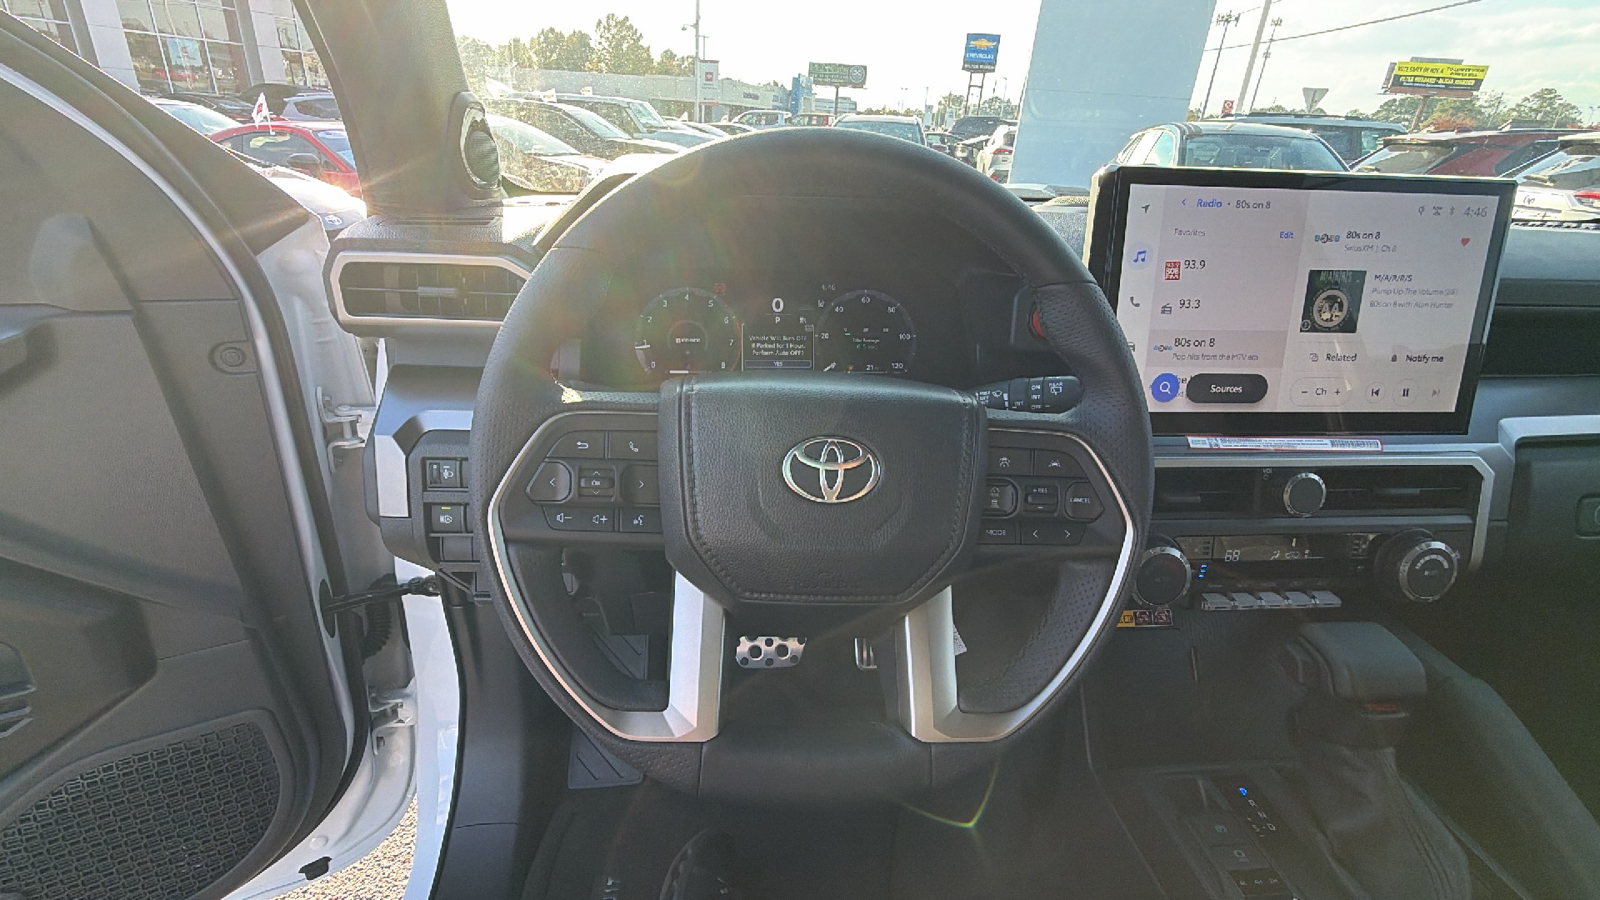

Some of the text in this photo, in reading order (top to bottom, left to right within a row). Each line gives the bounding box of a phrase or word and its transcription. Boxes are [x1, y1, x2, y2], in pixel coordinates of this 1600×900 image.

[1196, 198, 1222, 208] Radio
[1236, 200, 1250, 209] 80s
[1265, 201, 1271, 209] 8
[1464, 206, 1488, 217] 4:46
[1174, 228, 1206, 236] Favorites
[1346, 231, 1360, 239] 80s
[1184, 260, 1206, 270] 93.9
[1374, 274, 1413, 283] M/A/R/R/S
[772, 297, 784, 313] 0
[1179, 299, 1200, 309] 93.3
[1174, 337, 1215, 348] 80s on 8
[1325, 353, 1357, 362] Related
[1406, 354, 1429, 363] Notify
[1210, 385, 1242, 393] Sources
[1315, 388, 1327, 396] Ch
[1225, 550, 1240, 562] 68
